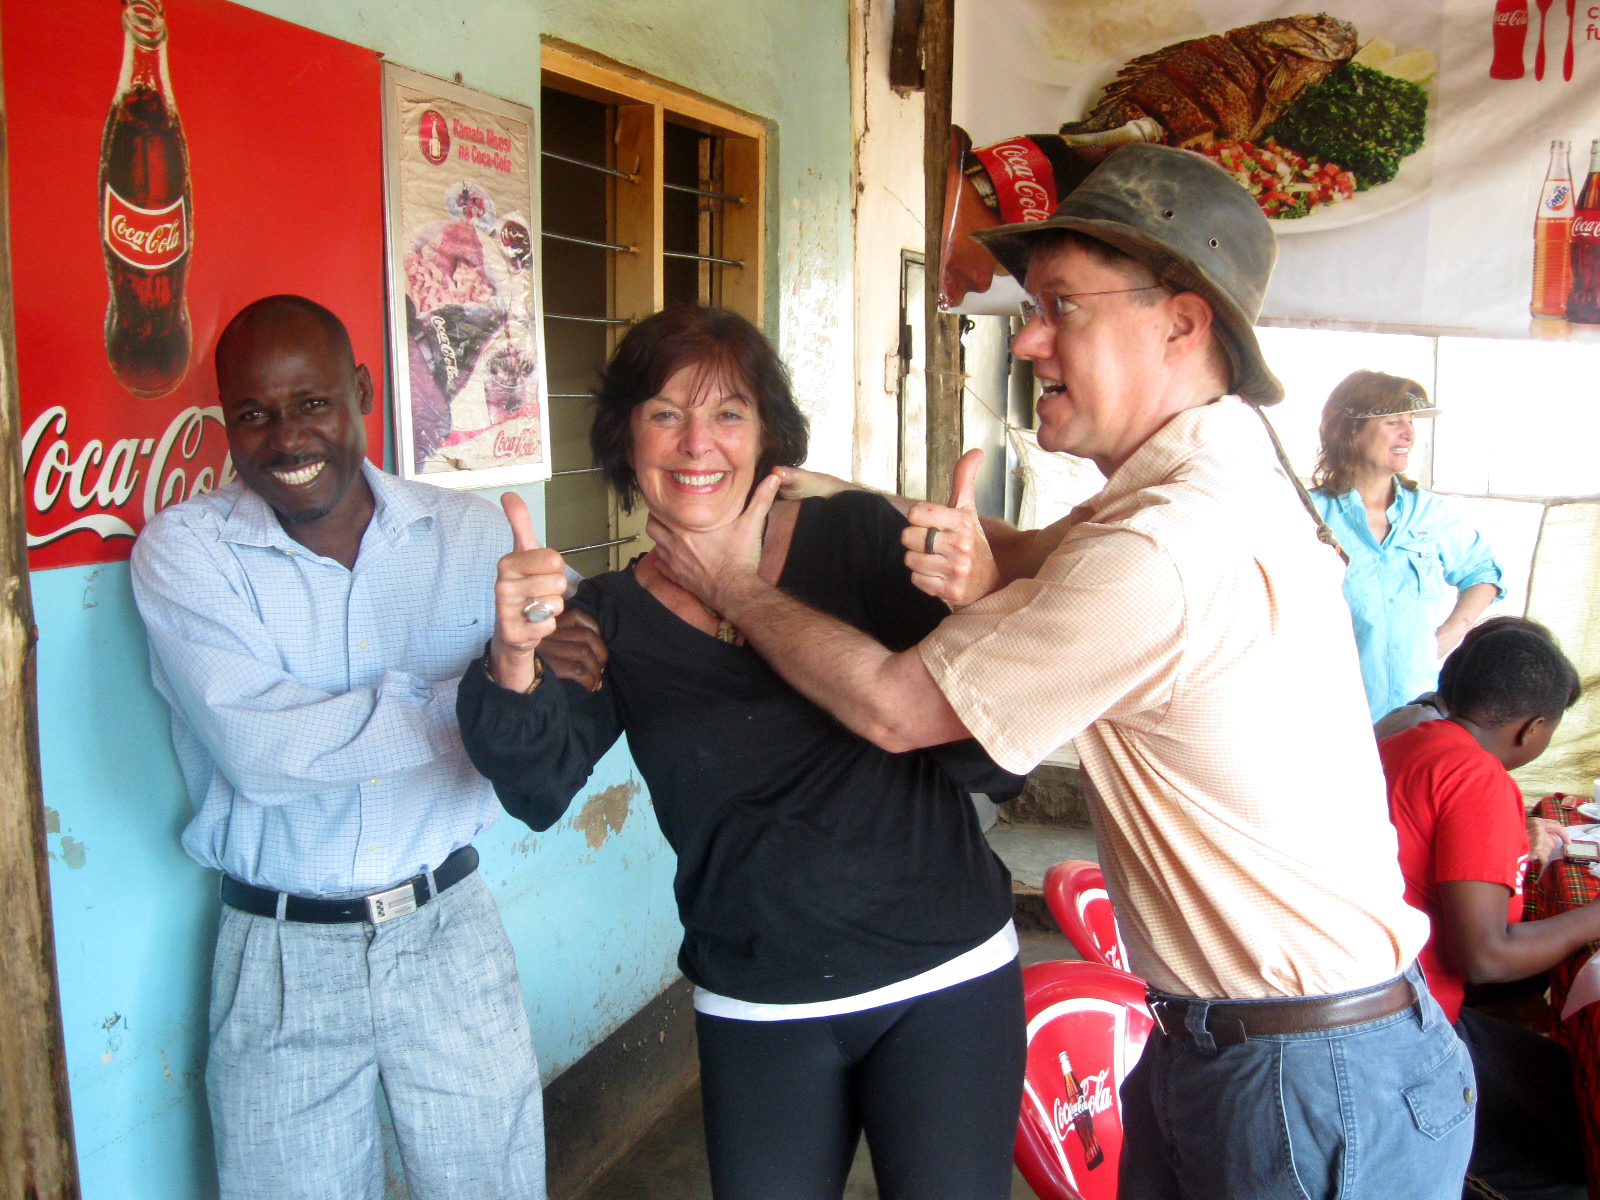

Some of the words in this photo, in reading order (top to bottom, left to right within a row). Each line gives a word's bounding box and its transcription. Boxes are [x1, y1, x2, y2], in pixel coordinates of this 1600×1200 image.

[453, 118, 485, 145] Kamata
[458, 145, 470, 161] na
[471, 145, 512, 173] Coca-Cola
[1545, 186, 1570, 209] Fanta
[112, 214, 181, 254] Coca-Cola
[1571, 216, 1600, 237] Coca-C
[431, 316, 459, 385] Coca-Cola
[21, 405, 238, 549] Coca-Co
[1054, 1067, 1112, 1141] Cocola
